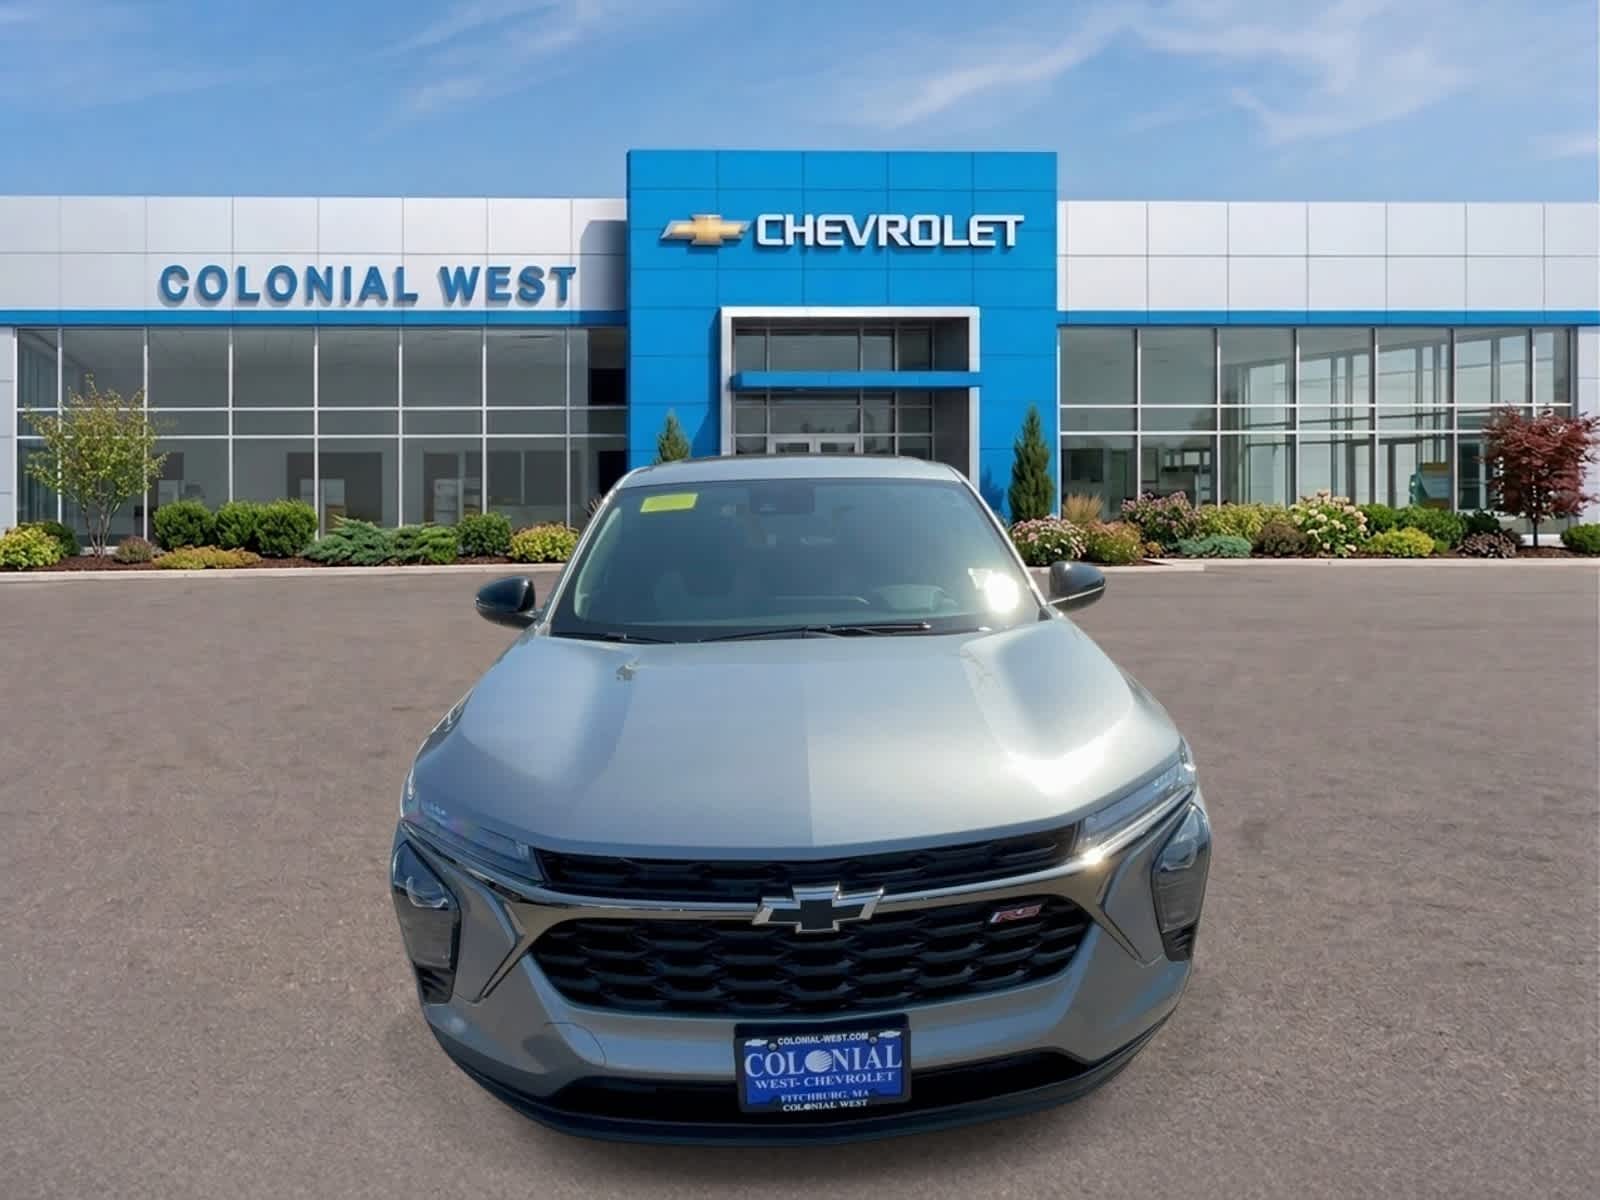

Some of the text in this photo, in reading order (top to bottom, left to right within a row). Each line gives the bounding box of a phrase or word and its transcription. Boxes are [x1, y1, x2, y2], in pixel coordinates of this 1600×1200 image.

[756, 213, 1025, 247] CHEVROLET
[159, 265, 577, 304] COLONIAL WEST
[990, 904, 1042, 923] RS
[777, 1033, 868, 1046] COLONIAL-WEST.COM
[744, 1045, 903, 1078] COLONIAL
[804, 1072, 895, 1087] CHEVROLET
[852, 1089, 870, 1098] MA
[783, 1098, 868, 1112] COLONIAL WEST
